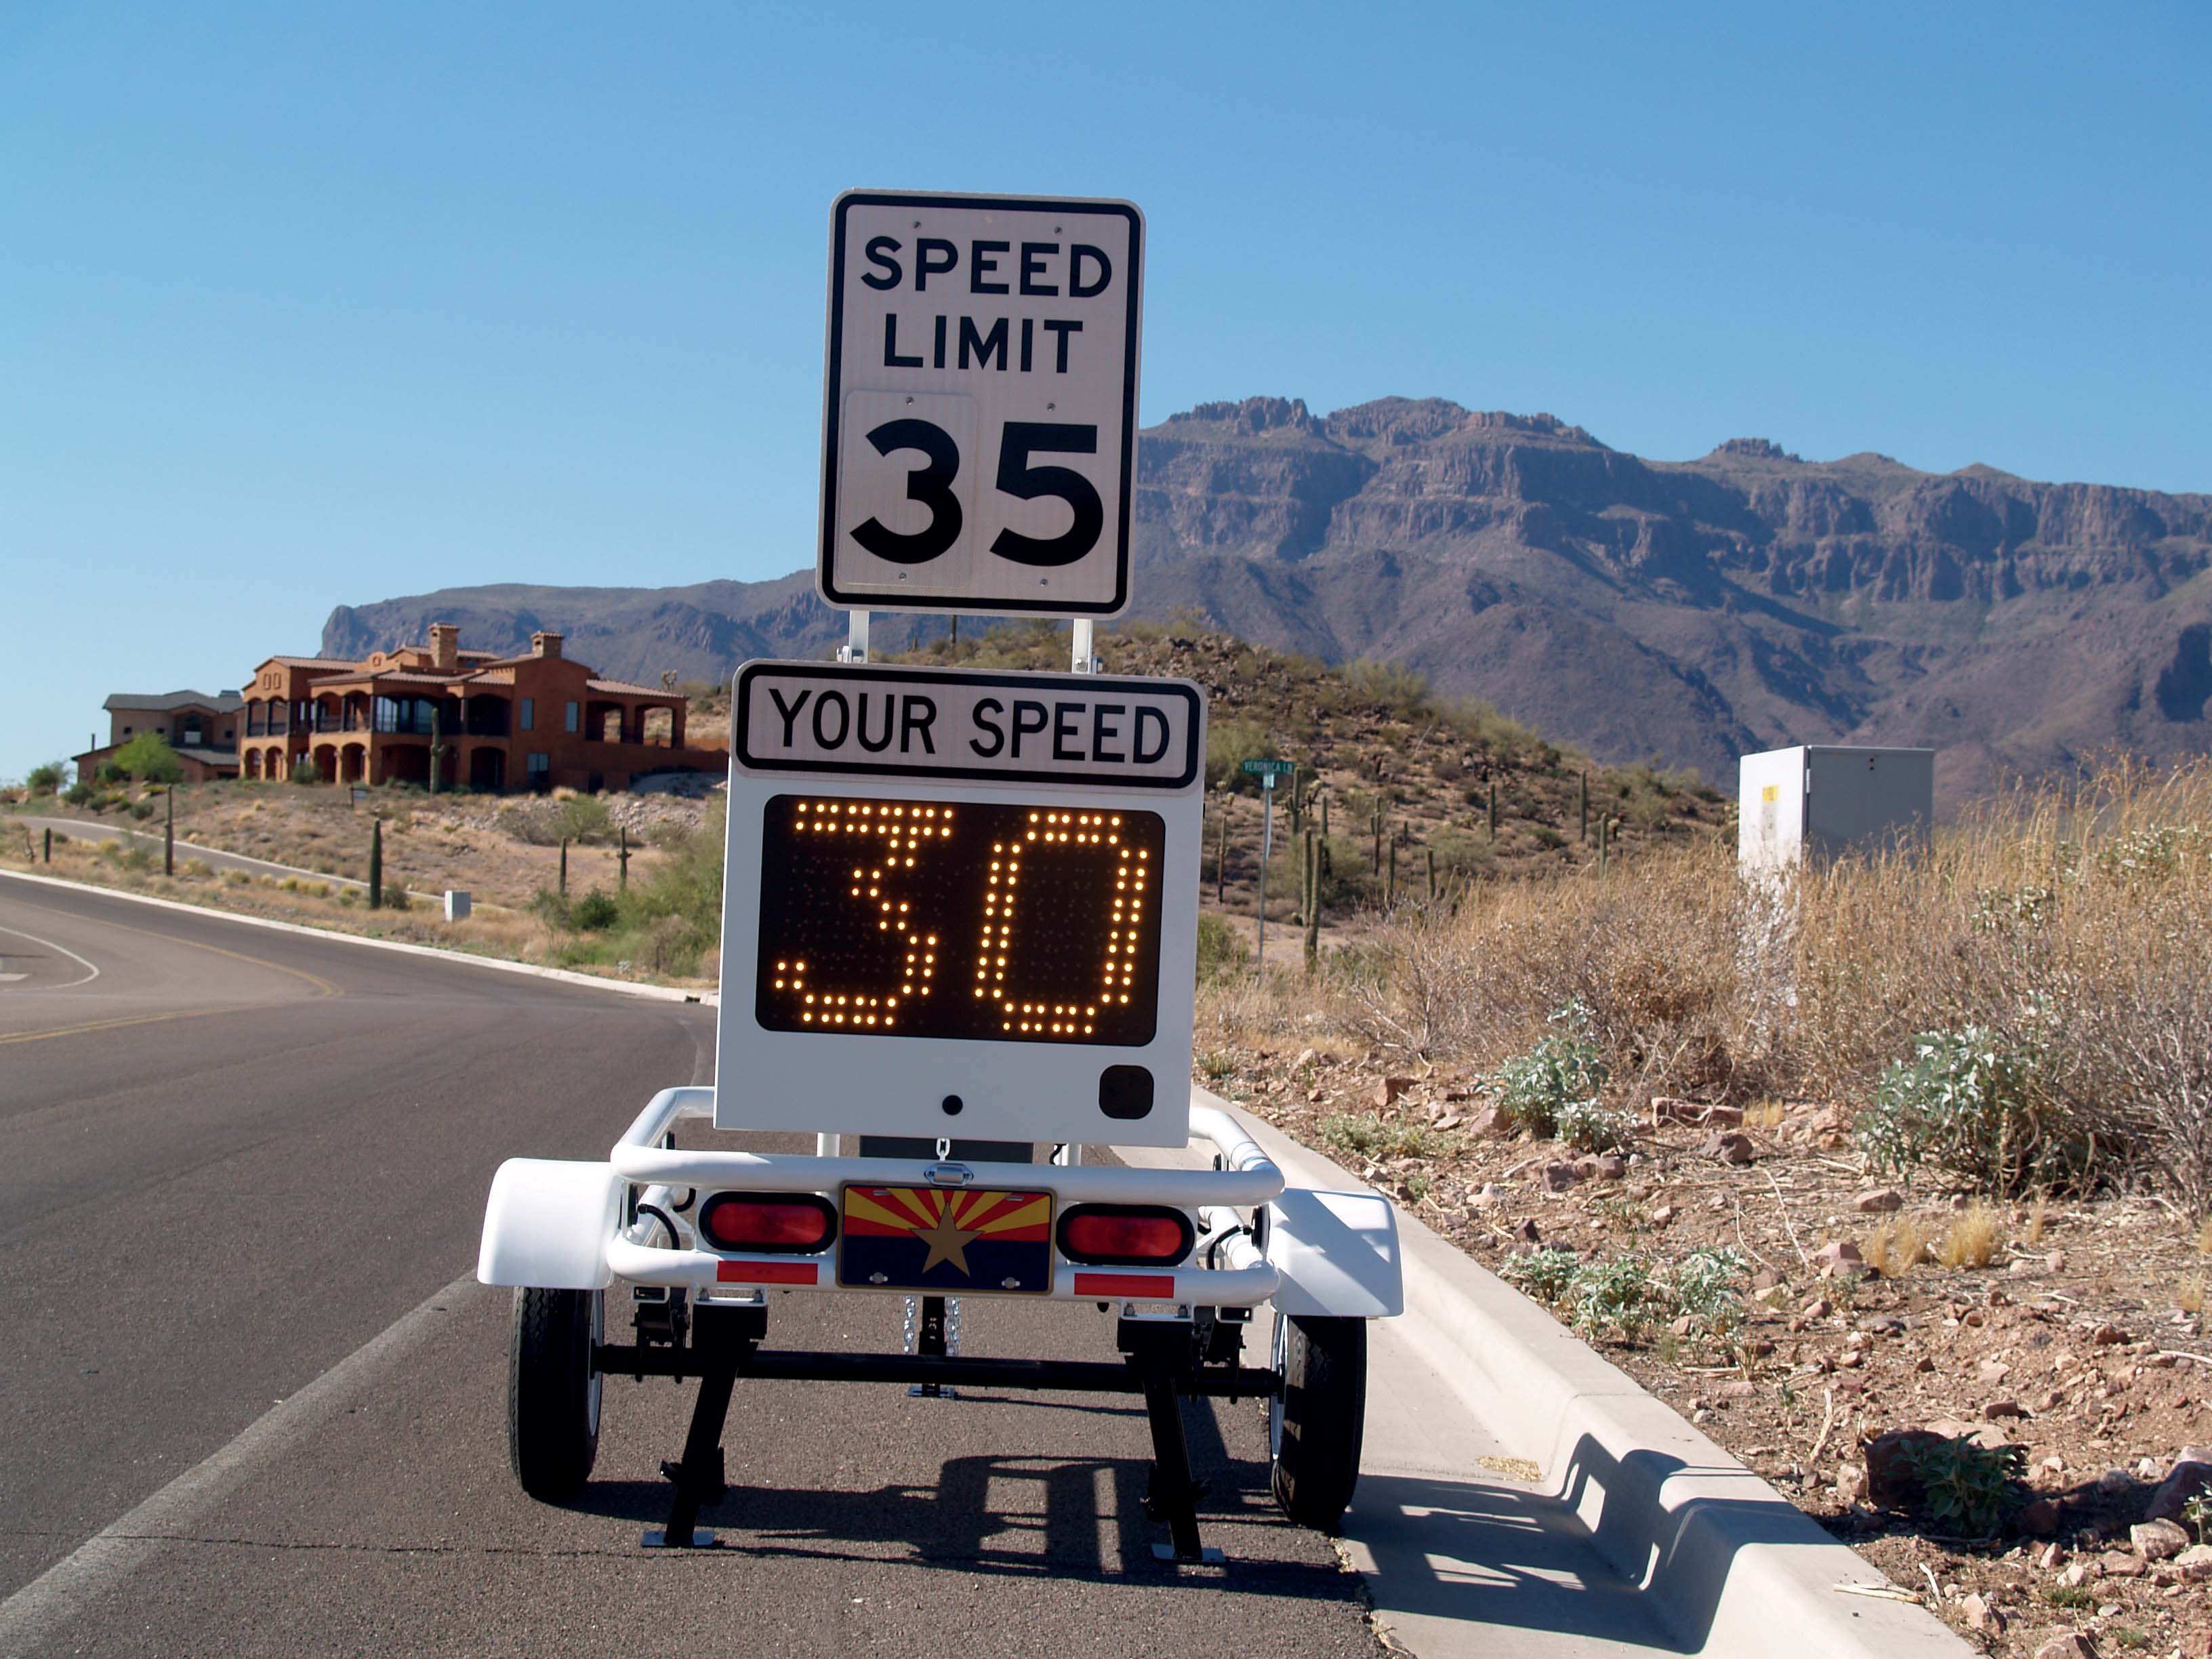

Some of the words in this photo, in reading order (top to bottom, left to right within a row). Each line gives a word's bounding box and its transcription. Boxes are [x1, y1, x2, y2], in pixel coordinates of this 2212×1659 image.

[860, 235, 1112, 298] SPEED
[884, 313, 1084, 373] LIMIT
[849, 418, 1104, 567] 35
[768, 688, 937, 754] YOUR
[969, 697, 1170, 764] SPEED
[1244, 760, 1281, 772] VERONICA
[775, 803, 1148, 1034] 30
